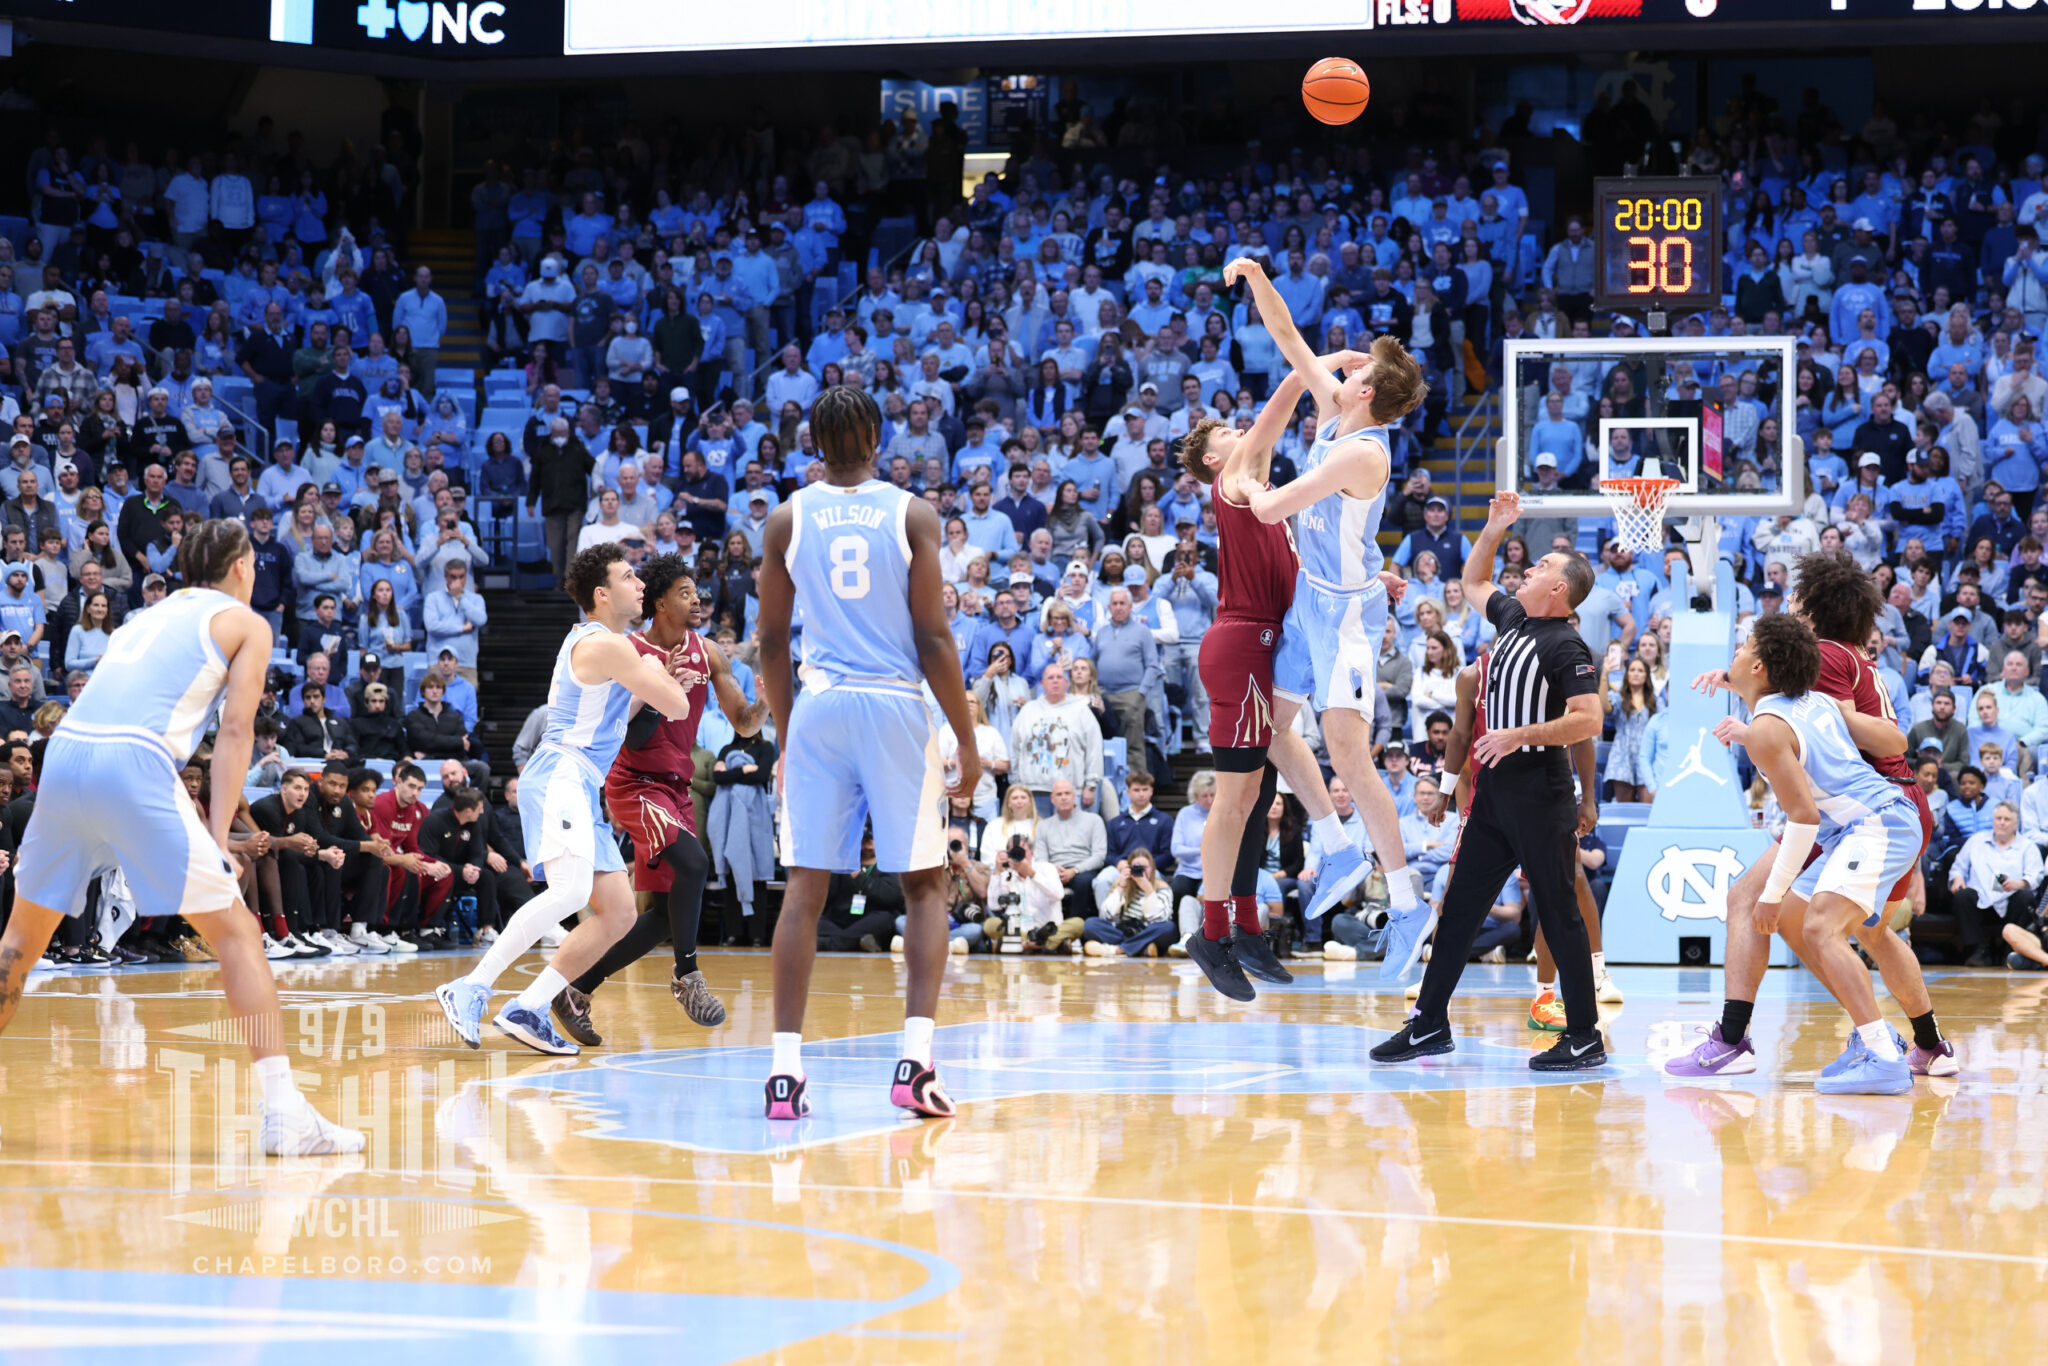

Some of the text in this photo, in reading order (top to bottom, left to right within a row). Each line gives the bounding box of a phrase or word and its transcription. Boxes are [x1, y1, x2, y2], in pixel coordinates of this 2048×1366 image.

[1615, 198, 1702, 231] 20:00
[1628, 236, 1692, 293] 30
[811, 505, 887, 530] WILSON
[829, 535, 871, 599] 8
[1811, 711, 1855, 761] 7
[775, 1078, 788, 1098] 0
[897, 1062, 912, 1082] 0
